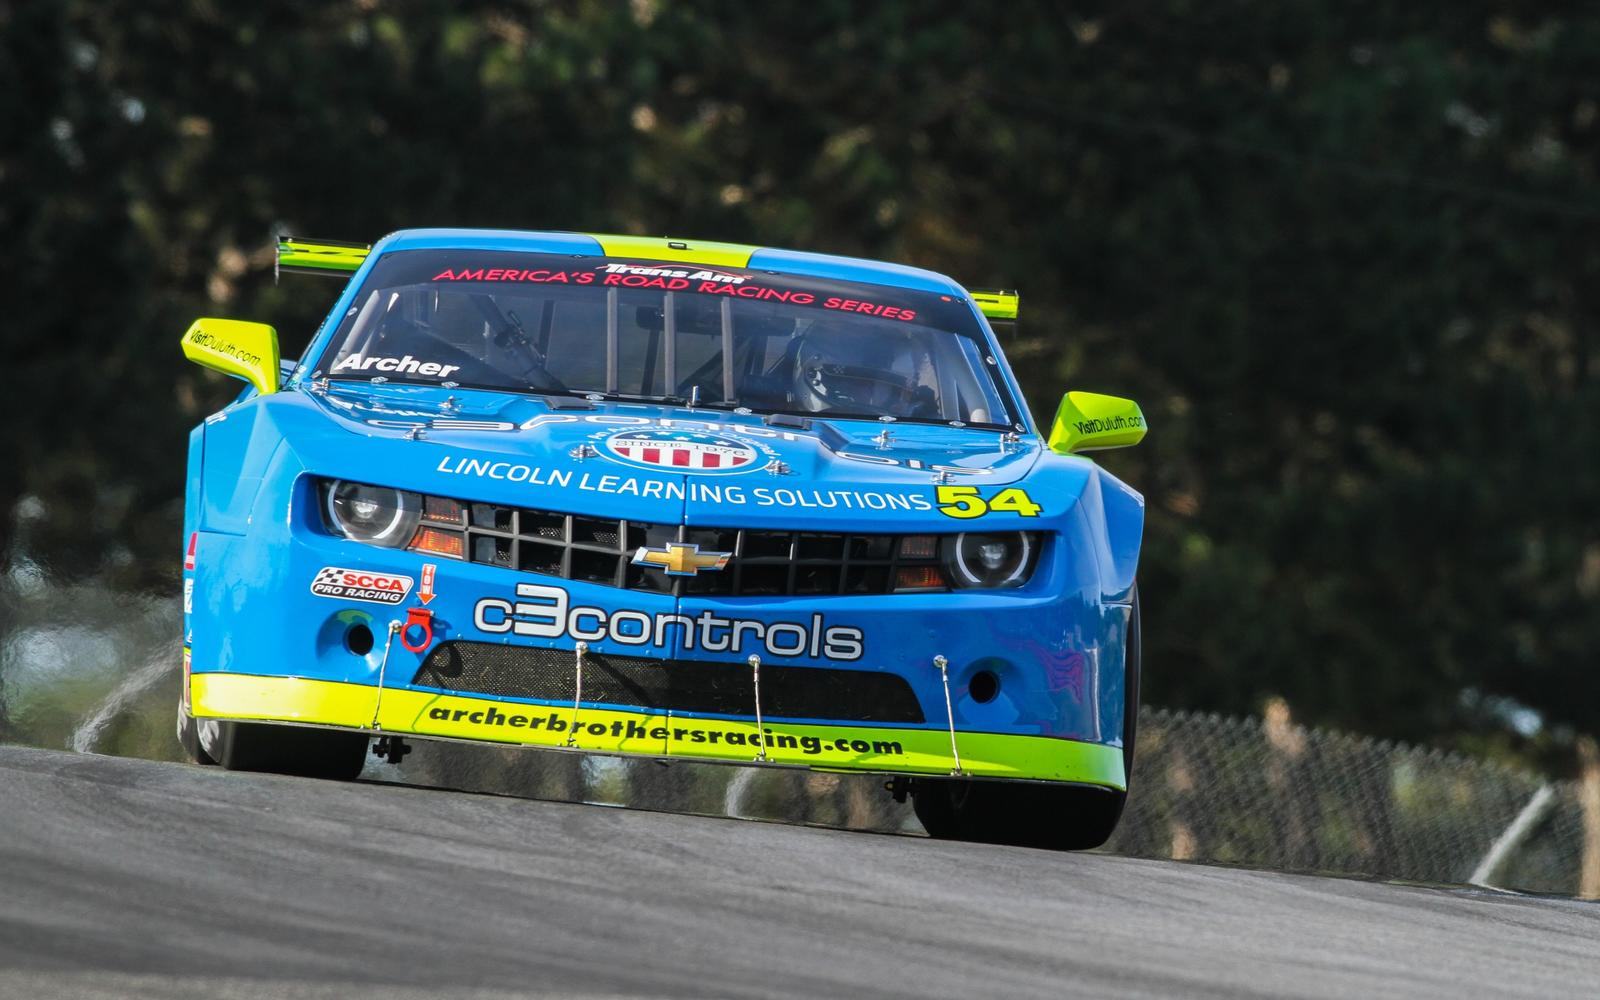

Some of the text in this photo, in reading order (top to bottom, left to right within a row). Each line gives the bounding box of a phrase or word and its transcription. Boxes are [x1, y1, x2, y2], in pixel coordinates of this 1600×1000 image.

[432, 269, 917, 321] AMERICA'S ROAD RACING SERIES
[190, 329, 261, 366] VisitDuluth.com
[333, 353, 460, 378] Archer
[615, 440, 746, 457] SINCE 1976
[437, 456, 932, 511] LINCOLN LEARNING SOLUTIONS
[936, 486, 1042, 519] 54
[314, 584, 401, 601] PRO RACING
[342, 574, 405, 592] SCCA
[423, 566, 433, 594] TOW
[473, 583, 865, 661] c3controls
[428, 707, 904, 756] archerbrothersracing.com
